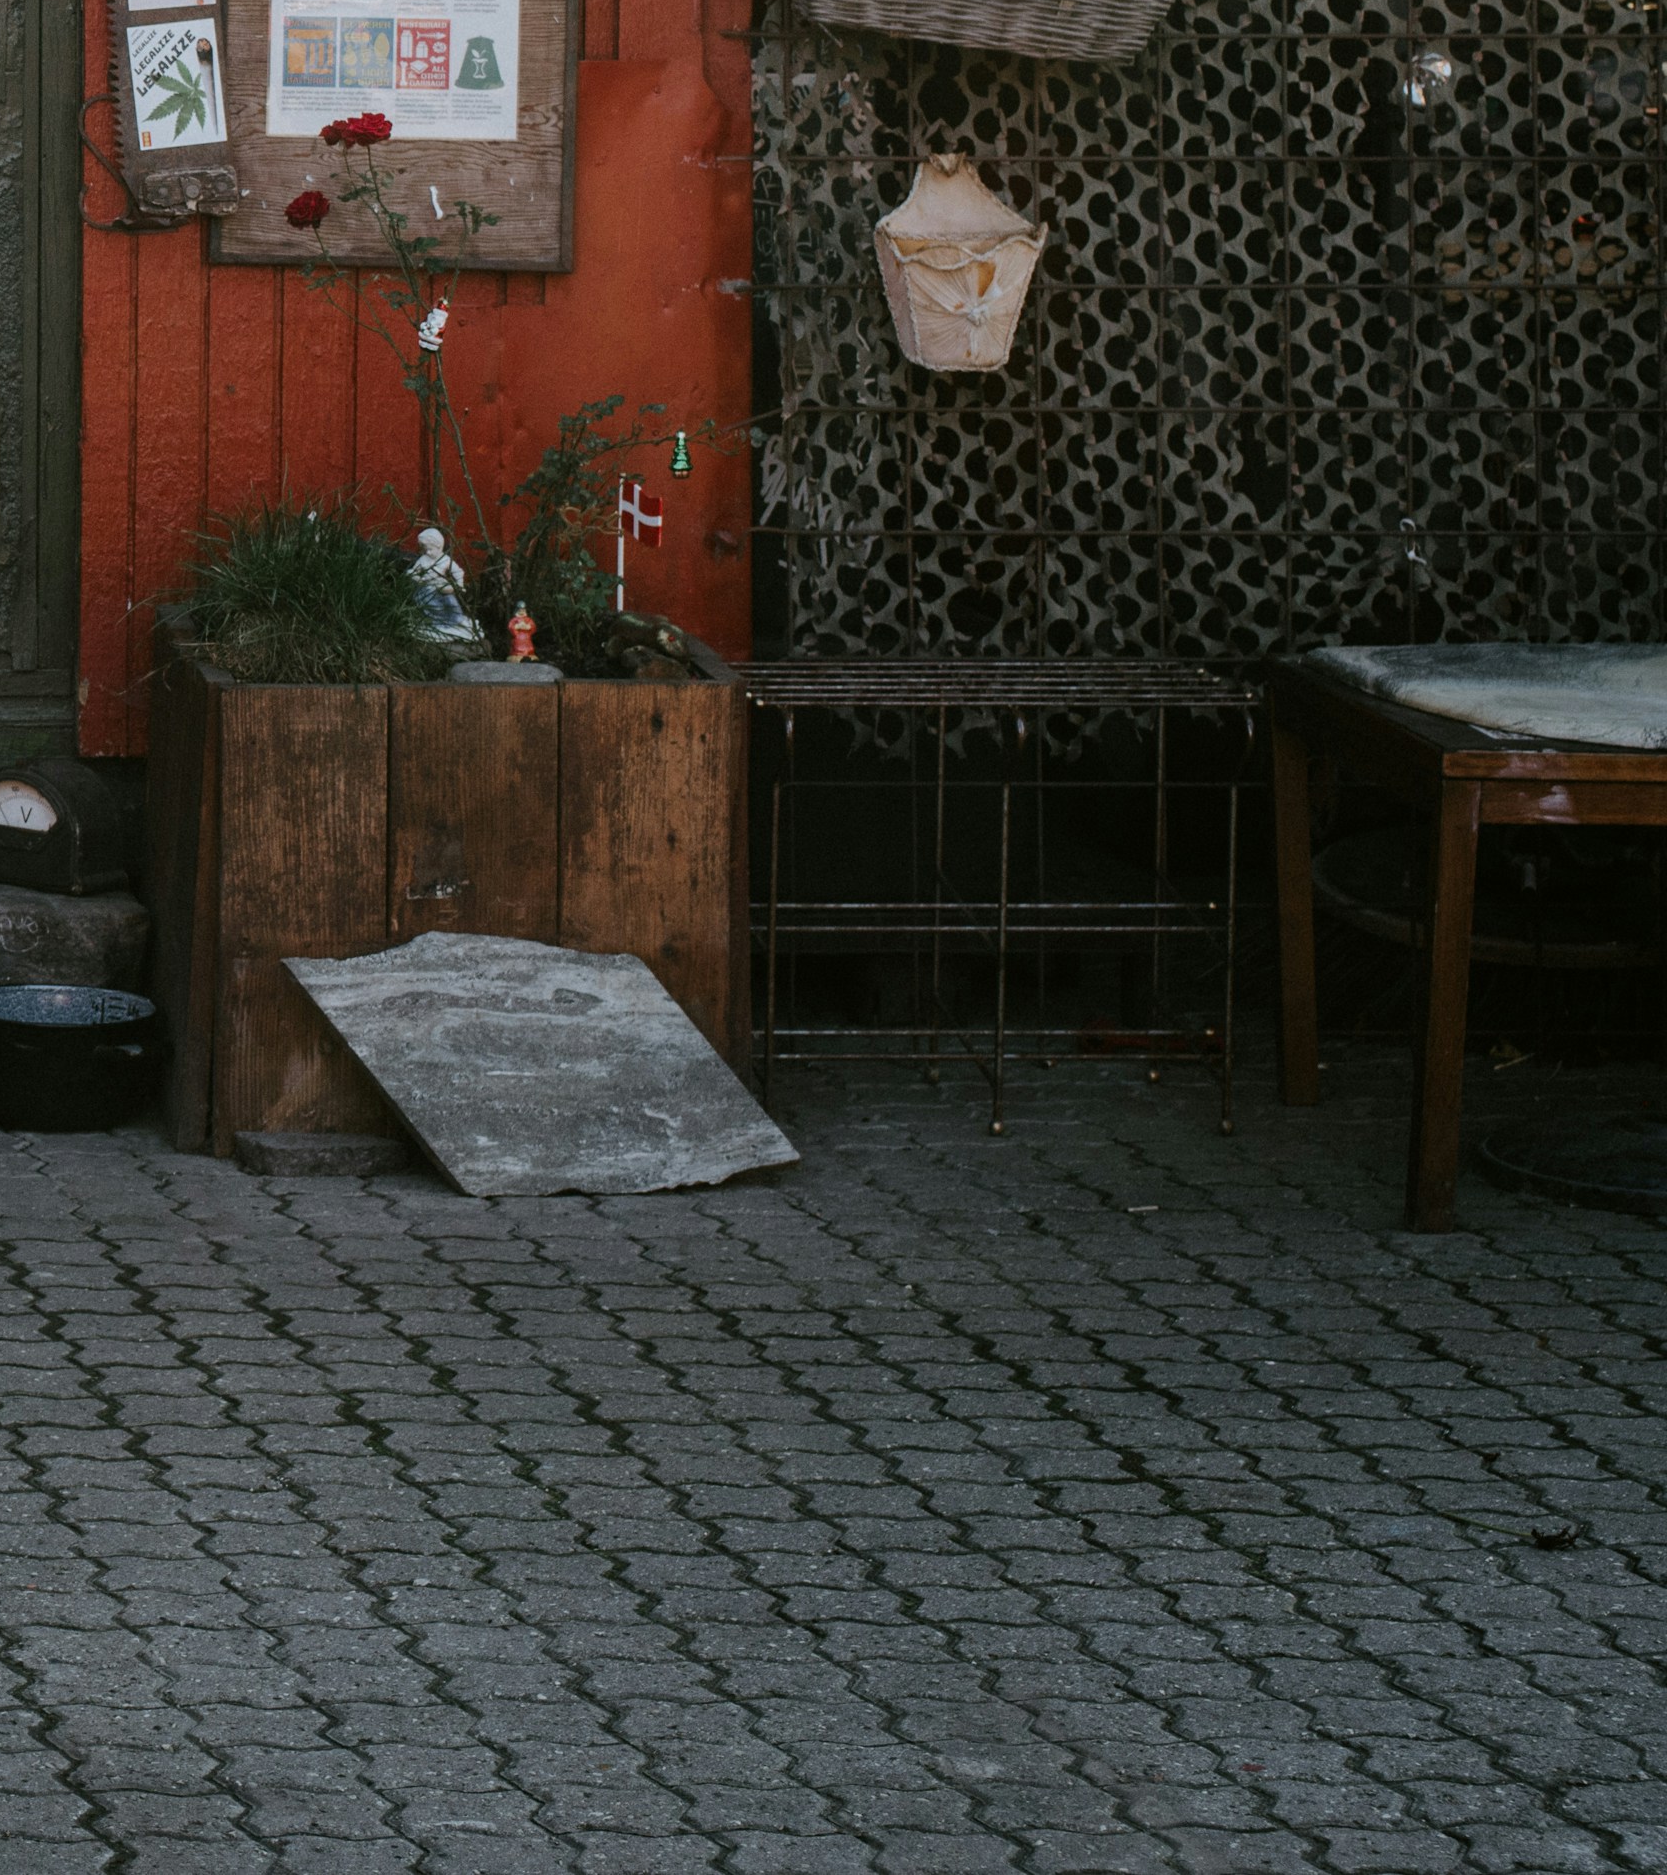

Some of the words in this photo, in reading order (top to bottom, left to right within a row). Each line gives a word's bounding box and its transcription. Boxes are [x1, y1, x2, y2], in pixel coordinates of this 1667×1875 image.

[132, 29, 157, 58] LEGALIZE
[134, 29, 175, 76] LEGALIZE
[136, 29, 196, 97] LEGALIZE
[432, 65, 445, 73] ALL
[20, 805, 33, 824] V
